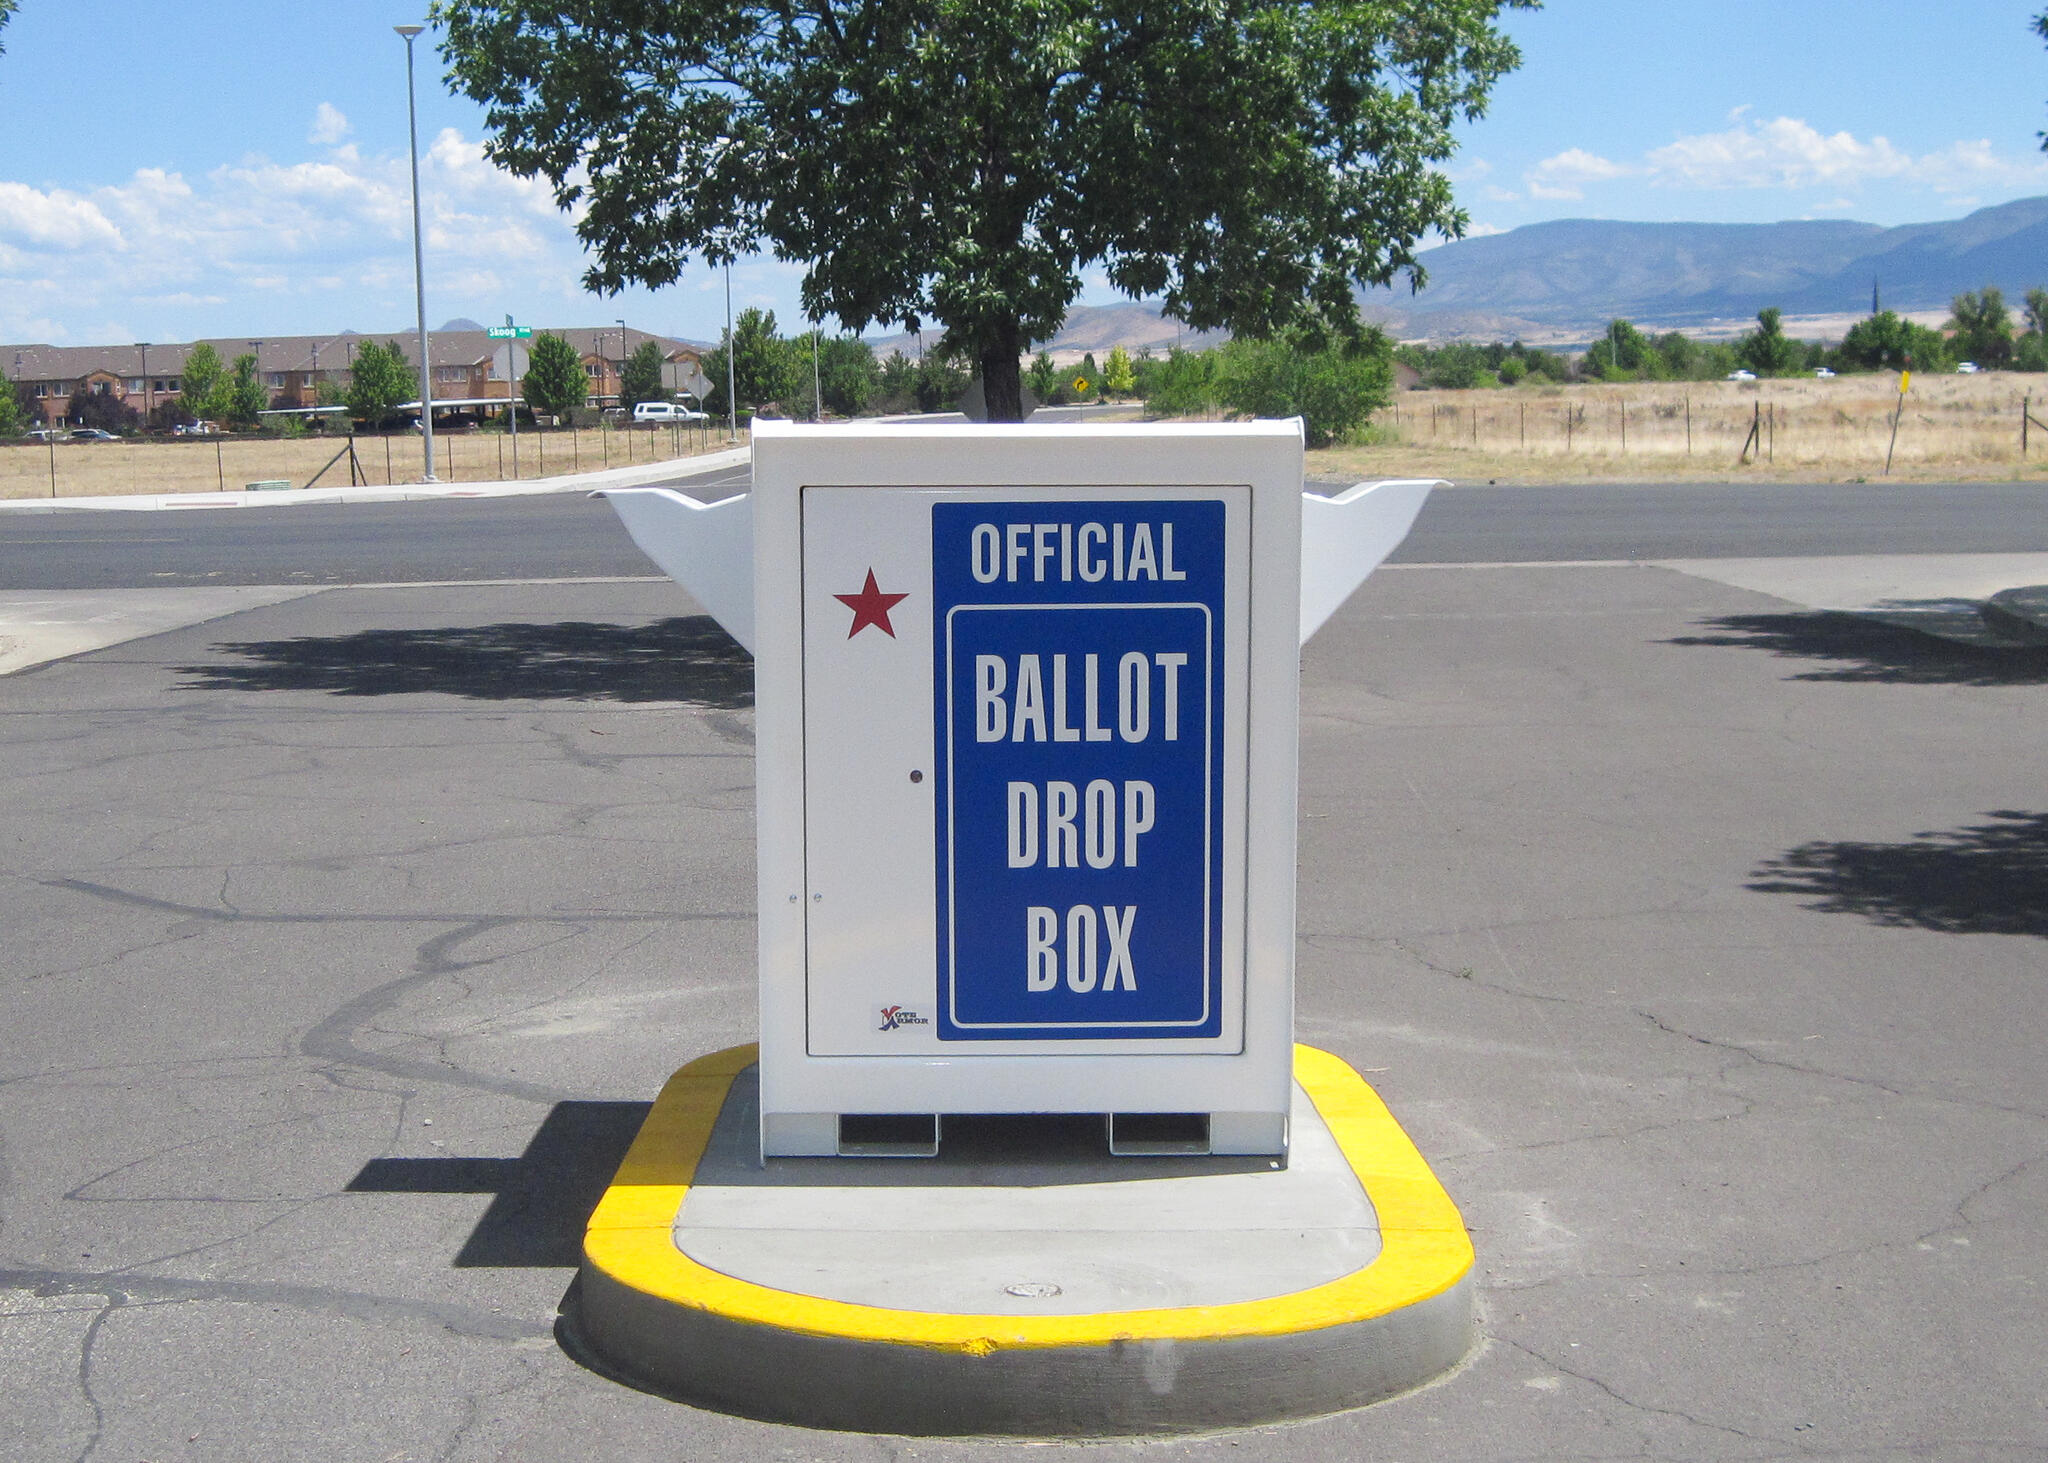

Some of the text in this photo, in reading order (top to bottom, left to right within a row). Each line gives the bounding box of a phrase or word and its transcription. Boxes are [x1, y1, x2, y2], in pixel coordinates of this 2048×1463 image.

[489, 327, 516, 338] Skoog
[971, 523, 1186, 583] OFFICIAL
[975, 652, 1188, 742] BALLOT
[1007, 780, 1155, 869] DROP
[1027, 905, 1137, 993] BOX
